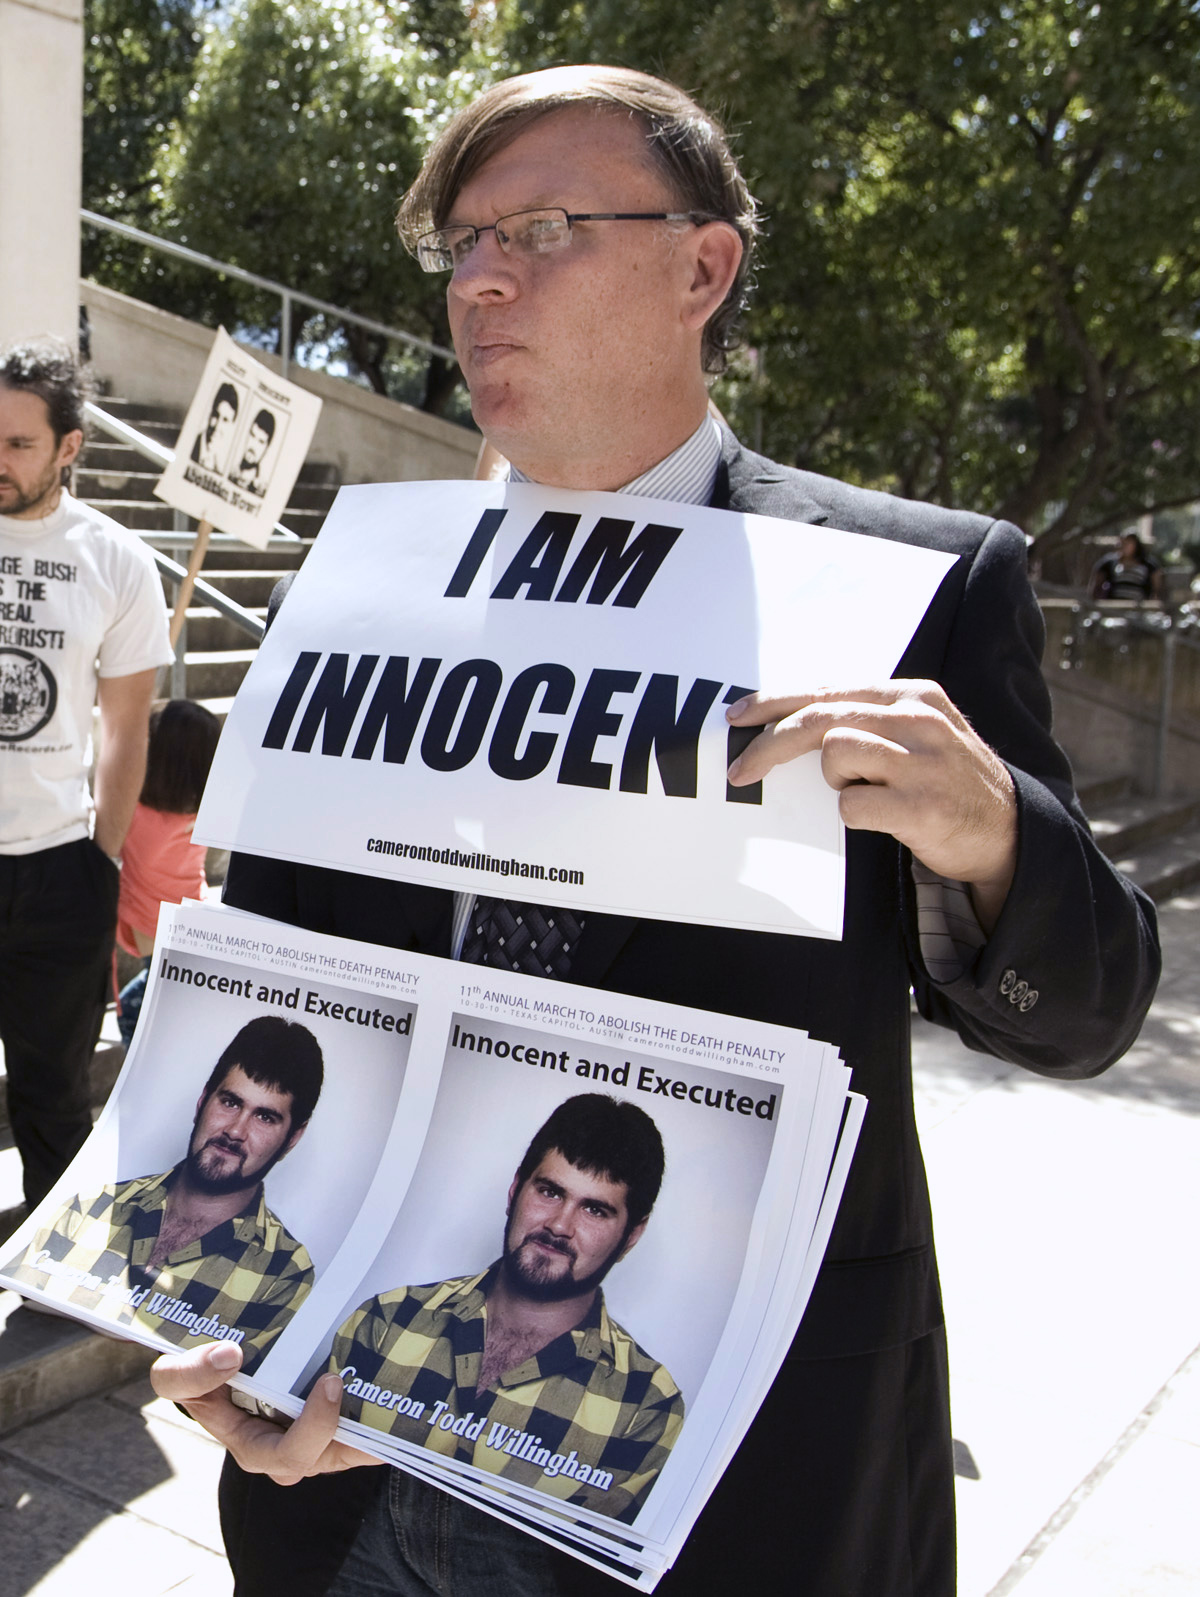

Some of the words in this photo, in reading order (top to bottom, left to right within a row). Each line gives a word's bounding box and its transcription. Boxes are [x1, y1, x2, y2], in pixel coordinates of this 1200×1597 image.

[16, 579, 47, 601] THE
[34, 559, 77, 583] BUSH
[443, 508, 509, 599] I
[489, 510, 684, 609] AM
[366, 837, 585, 886] camerontoddwillingham.com
[186, 927, 223, 944] ANNUAL
[225, 935, 260, 952] MARCH
[261, 942, 274, 954] TO
[276, 946, 317, 963] ABOLISH
[318, 955, 337, 969] THE
[339, 960, 372, 976] DEATH
[374, 967, 421, 987] PENALTY
[206, 943, 228, 954] TEXAS
[230, 948, 261, 961] CAPITOL
[270, 957, 298, 969] AUSTIN
[299, 964, 418, 996] camerontoddwillingham.com
[160, 958, 253, 999] Innocent
[256, 985, 301, 1010] and
[303, 990, 413, 1037] Executed
[459, 984, 482, 999] 11th
[483, 989, 530, 1010] ANNUAL
[533, 1000, 577, 1020] MARCH
[579, 1009, 596, 1024] TO
[597, 1013, 651, 1036] ABOLISH
[653, 1025, 678, 1042] THE
[681, 1031, 723, 1052] DEATH
[726, 1041, 786, 1064] PENALTY
[460, 999, 500, 1014] 10-30-10
[510, 1008, 539, 1023] TEXAS
[542, 1015, 581, 1031] CAPITOL
[589, 1026, 625, 1041] AUSTIN
[627, 1034, 781, 1074] camerontoddwillingham.com
[451, 1024, 570, 1073] Innocent
[574, 1057, 631, 1087] and
[636, 1066, 777, 1121] Executed
[144, 1291, 246, 1344] Willingham
[338, 1365, 428, 1420] Cameron
[427, 1399, 488, 1442] Todd
[485, 1421, 615, 1492] Willingham
